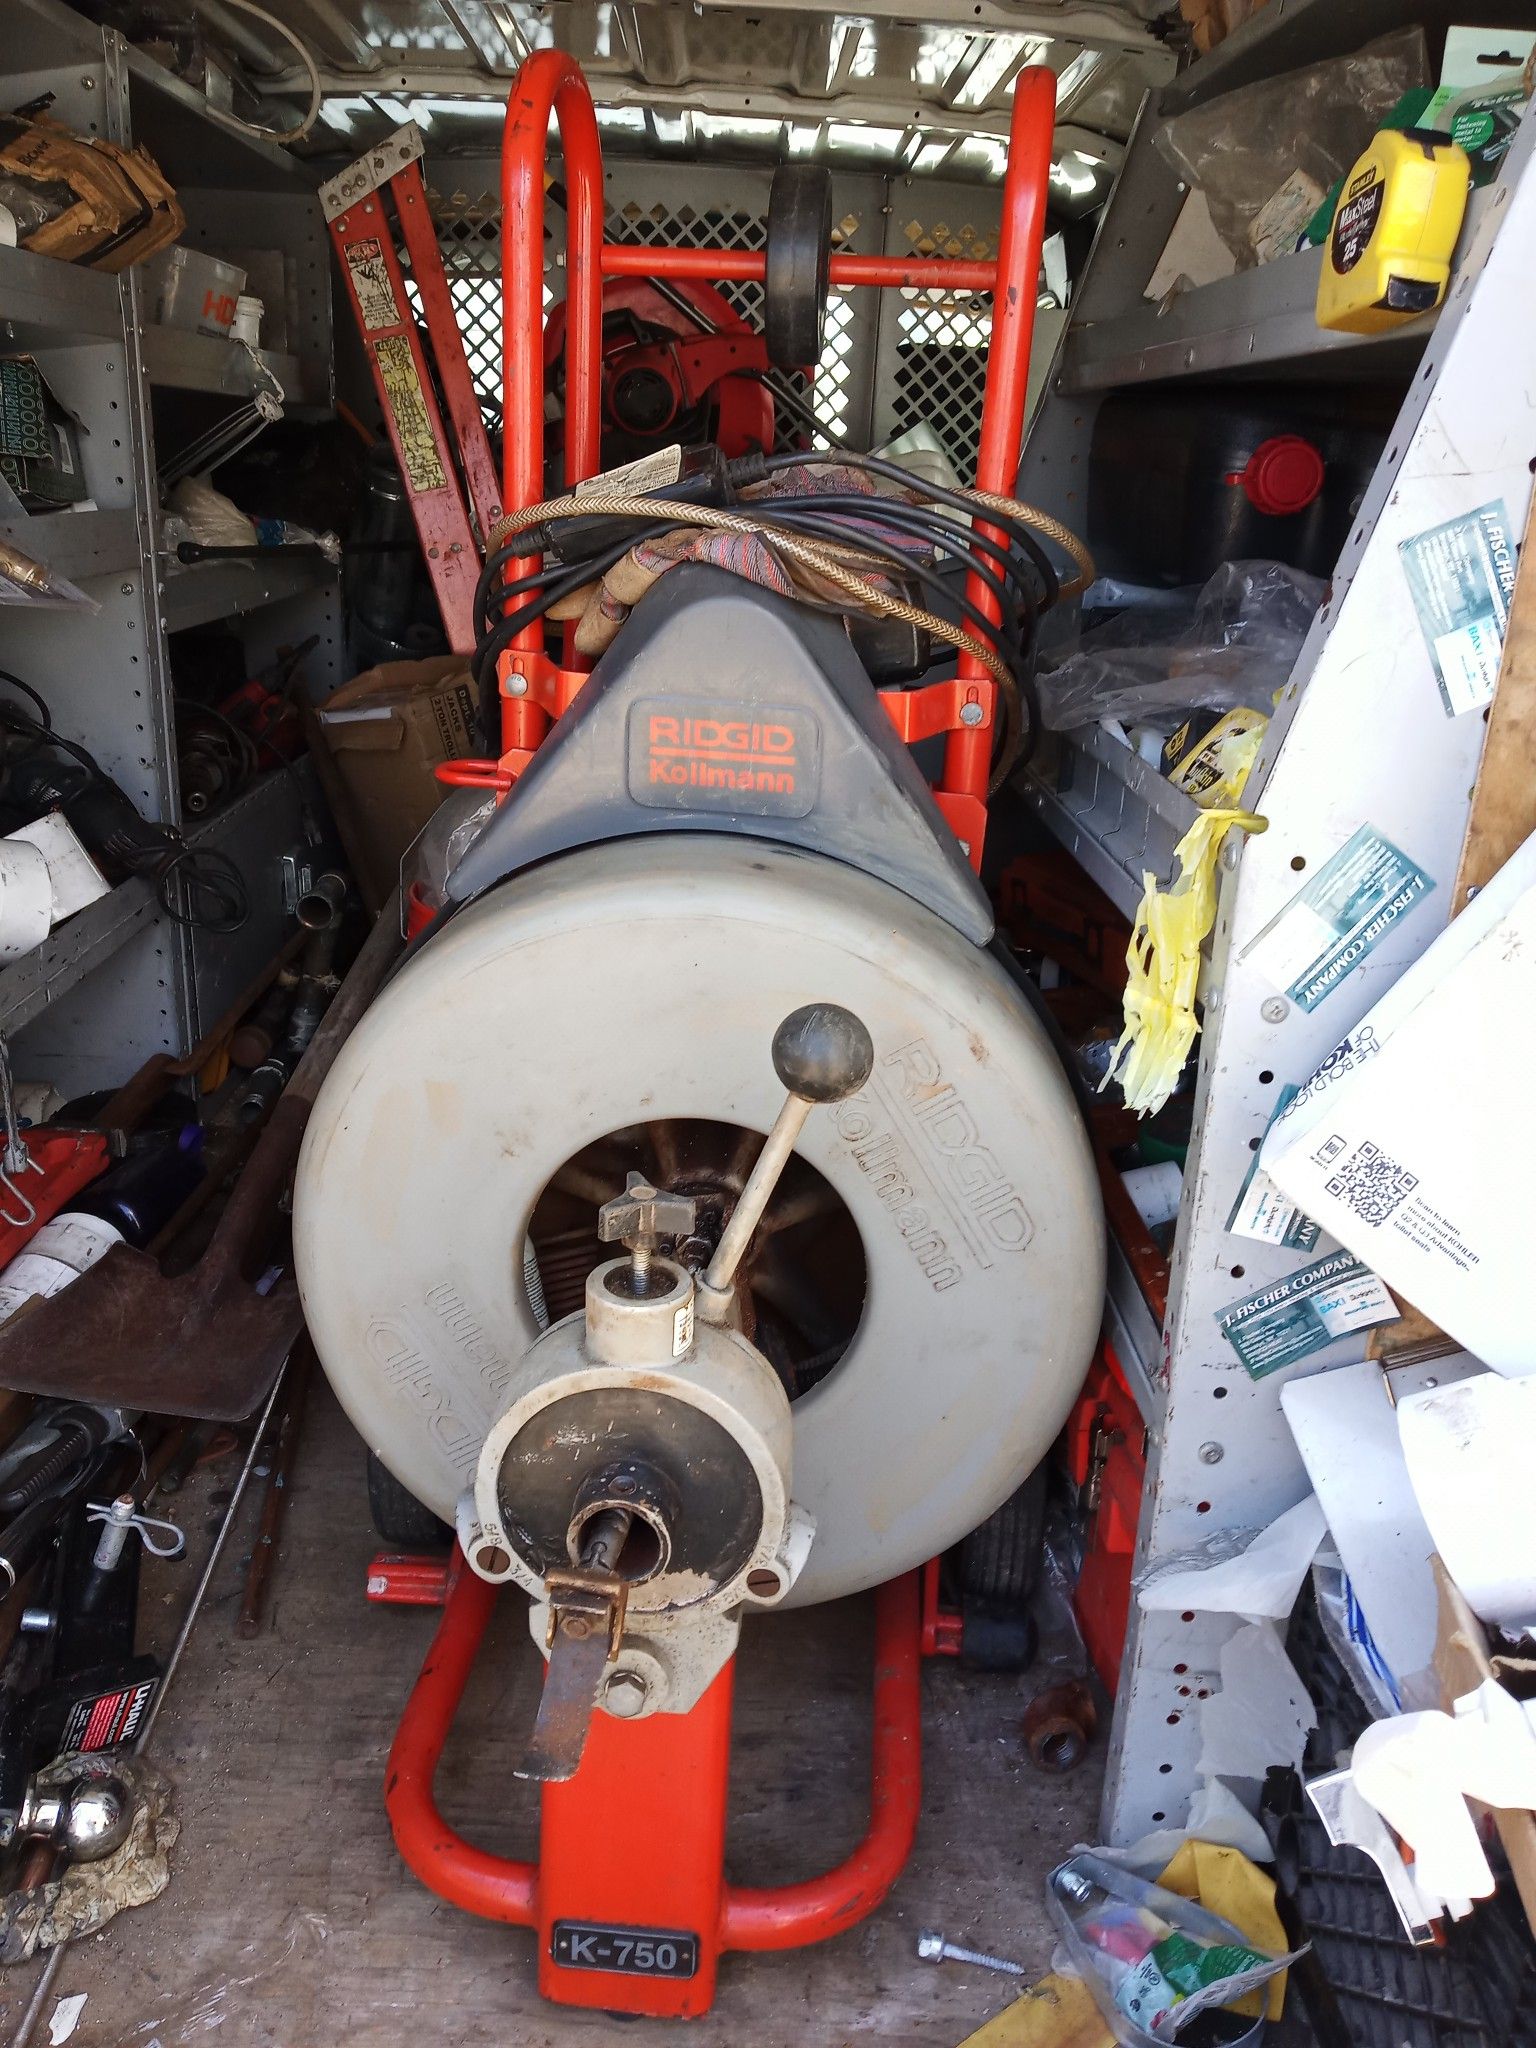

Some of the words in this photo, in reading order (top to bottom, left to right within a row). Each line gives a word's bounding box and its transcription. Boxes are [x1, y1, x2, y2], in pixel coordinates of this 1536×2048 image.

[1340, 187, 1378, 228] MaxSteel
[1343, 237, 1357, 263] 25
[1480, 511, 1498, 525] J.
[1486, 526, 1515, 594] FISCHER
[436, 706, 447, 728] TON
[446, 694, 462, 732] JACKS
[650, 715, 795, 753] RIDGID
[650, 759, 794, 795] Kollmann
[1411, 875, 1425, 890] J.
[1364, 887, 1415, 942] FISCHER
[1303, 939, 1366, 1005] COMPANY
[1353, 1038, 1380, 1064] THE
[1315, 1057, 1354, 1091] BOLD
[880, 1037, 1035, 1252] RIDGID
[1426, 1220, 1448, 1240] about
[1448, 1236, 1480, 1264] KOHLER
[1225, 1313, 1236, 1328] J.
[1236, 1284, 1291, 1320] FISCHER
[1319, 1296, 1347, 1315] BAXI
[511, 1562, 533, 1587] 3/4
[119, 1684, 151, 1742] U-HAUL
[570, 1934, 677, 1970] K-750
